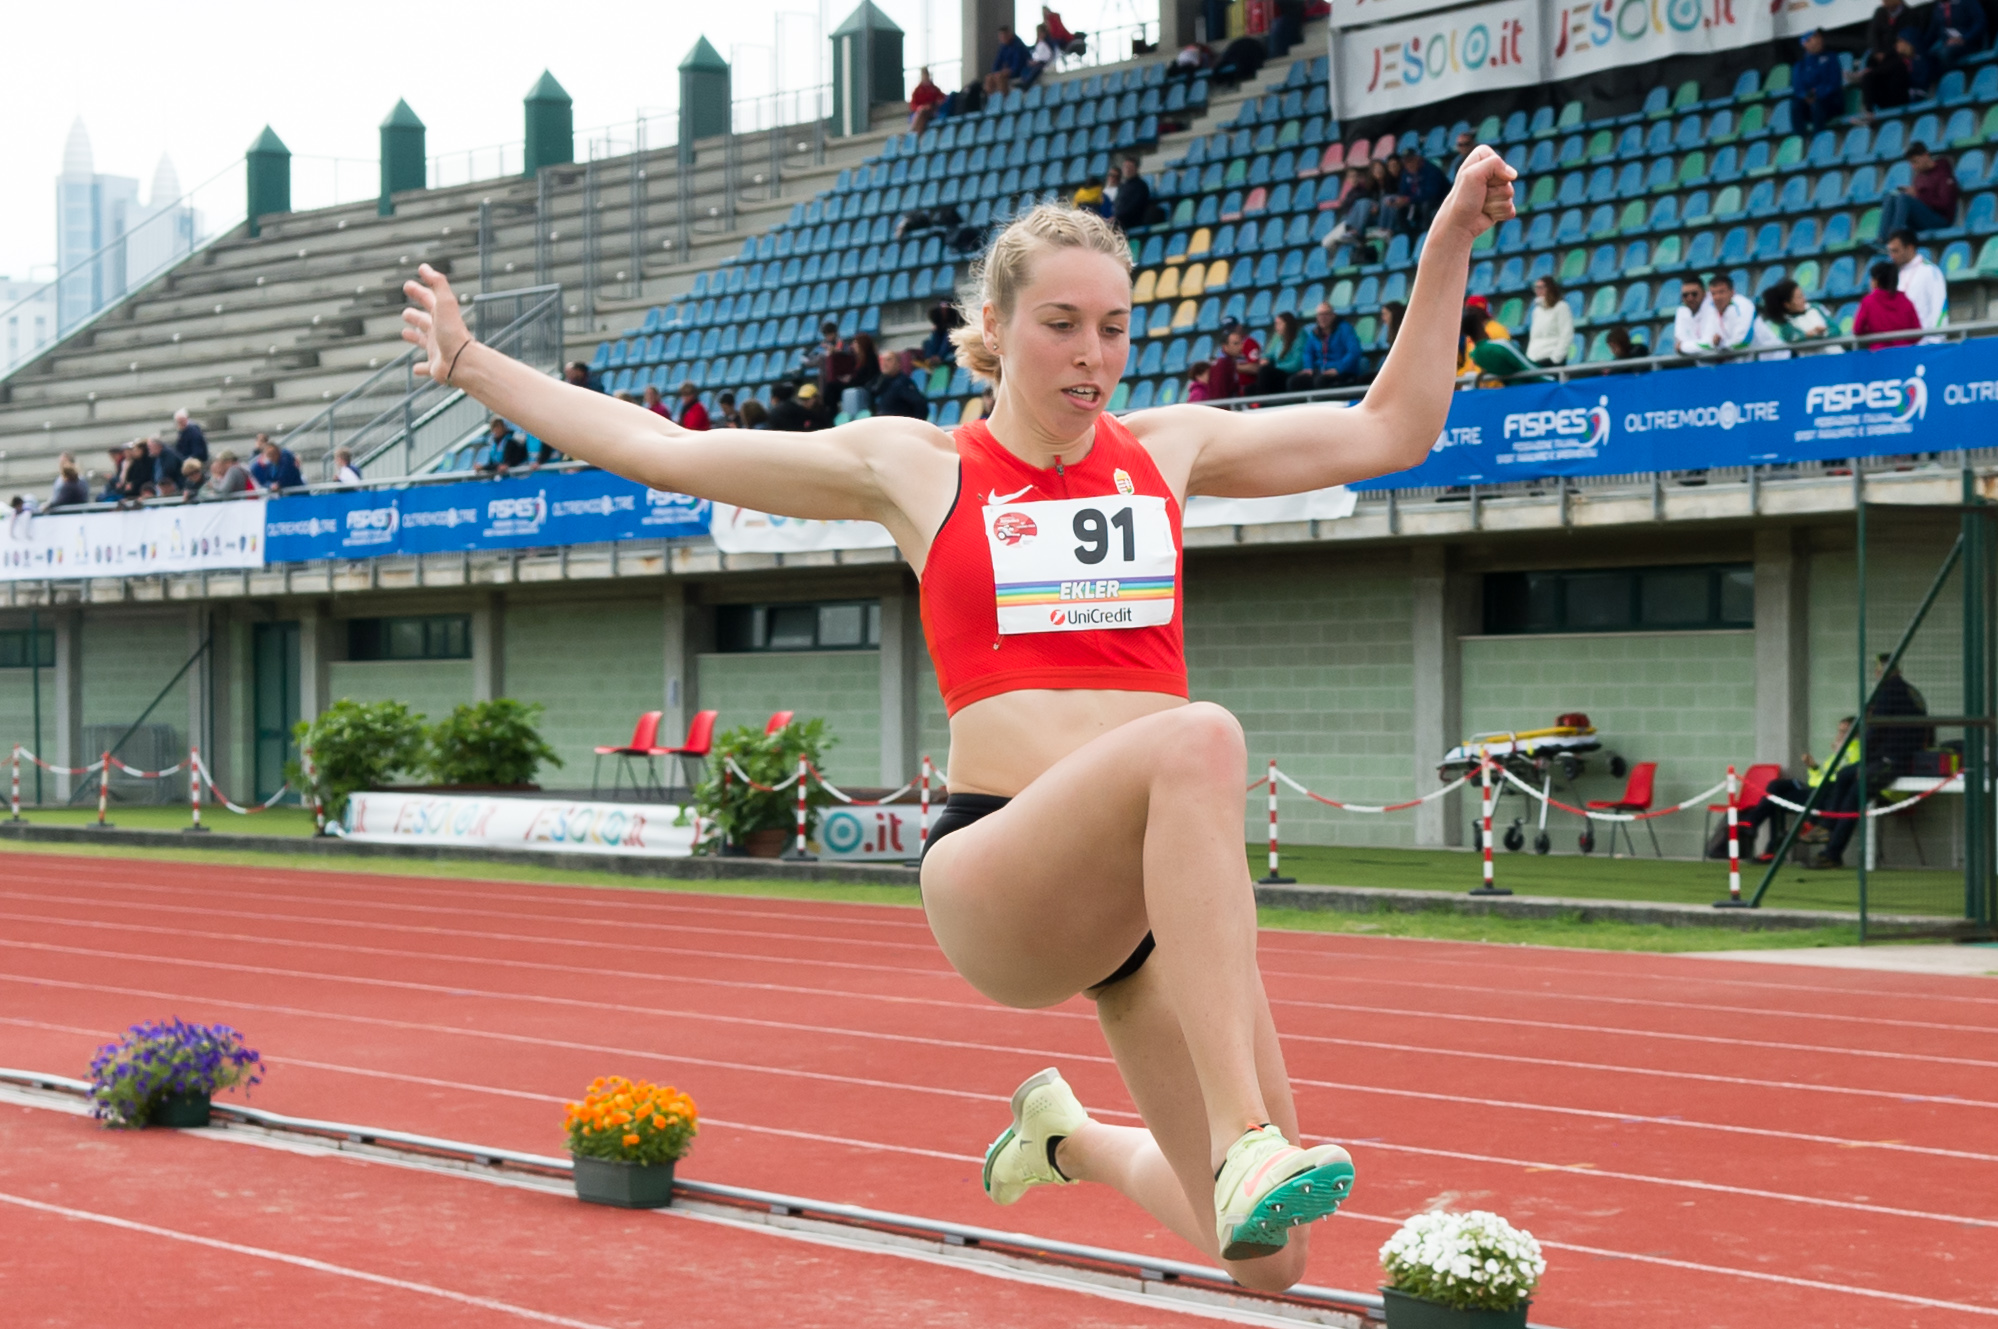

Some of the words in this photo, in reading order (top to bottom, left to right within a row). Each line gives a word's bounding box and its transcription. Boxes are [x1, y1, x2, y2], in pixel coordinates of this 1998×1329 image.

[1806, 378, 1903, 415] FISPES
[1943, 380, 1998, 406] OLTR
[1503, 407, 1589, 439] FISPES
[1072, 506, 1136, 565] 91
[1059, 579, 1121, 601] EKLER
[1067, 606, 1133, 625] UniCredit
